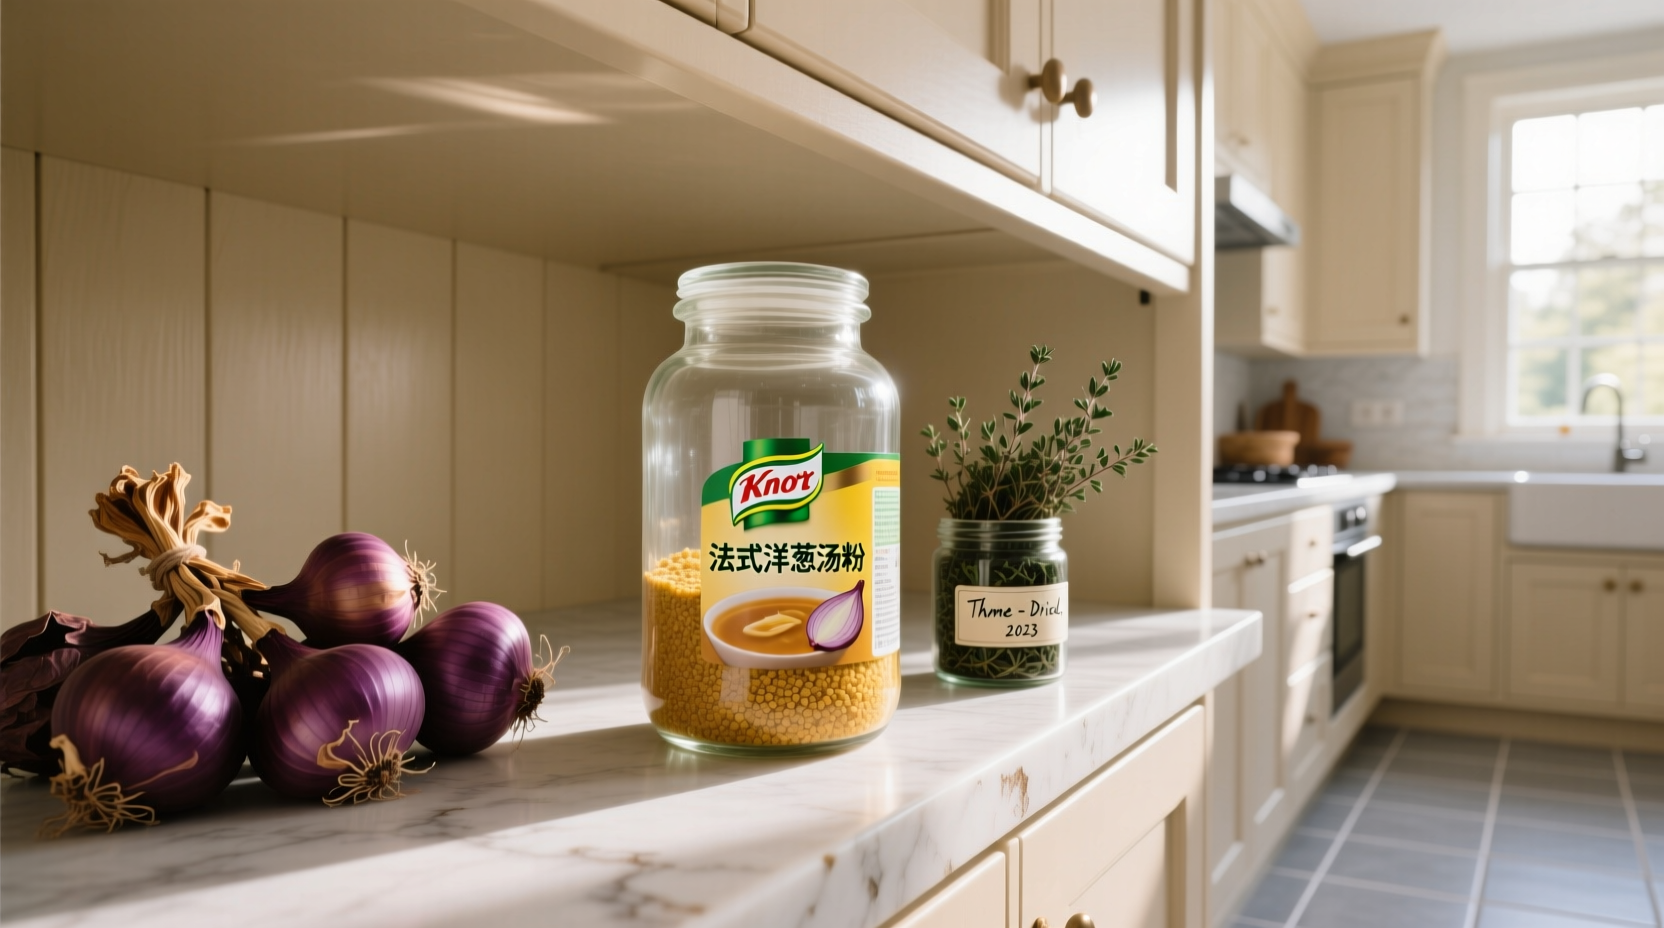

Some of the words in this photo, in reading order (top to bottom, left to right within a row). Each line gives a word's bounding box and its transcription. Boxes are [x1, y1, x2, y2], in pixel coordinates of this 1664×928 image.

[708, 541, 865, 574] 法式洋葱汤粉
[1005, 623, 1038, 637] 2023
